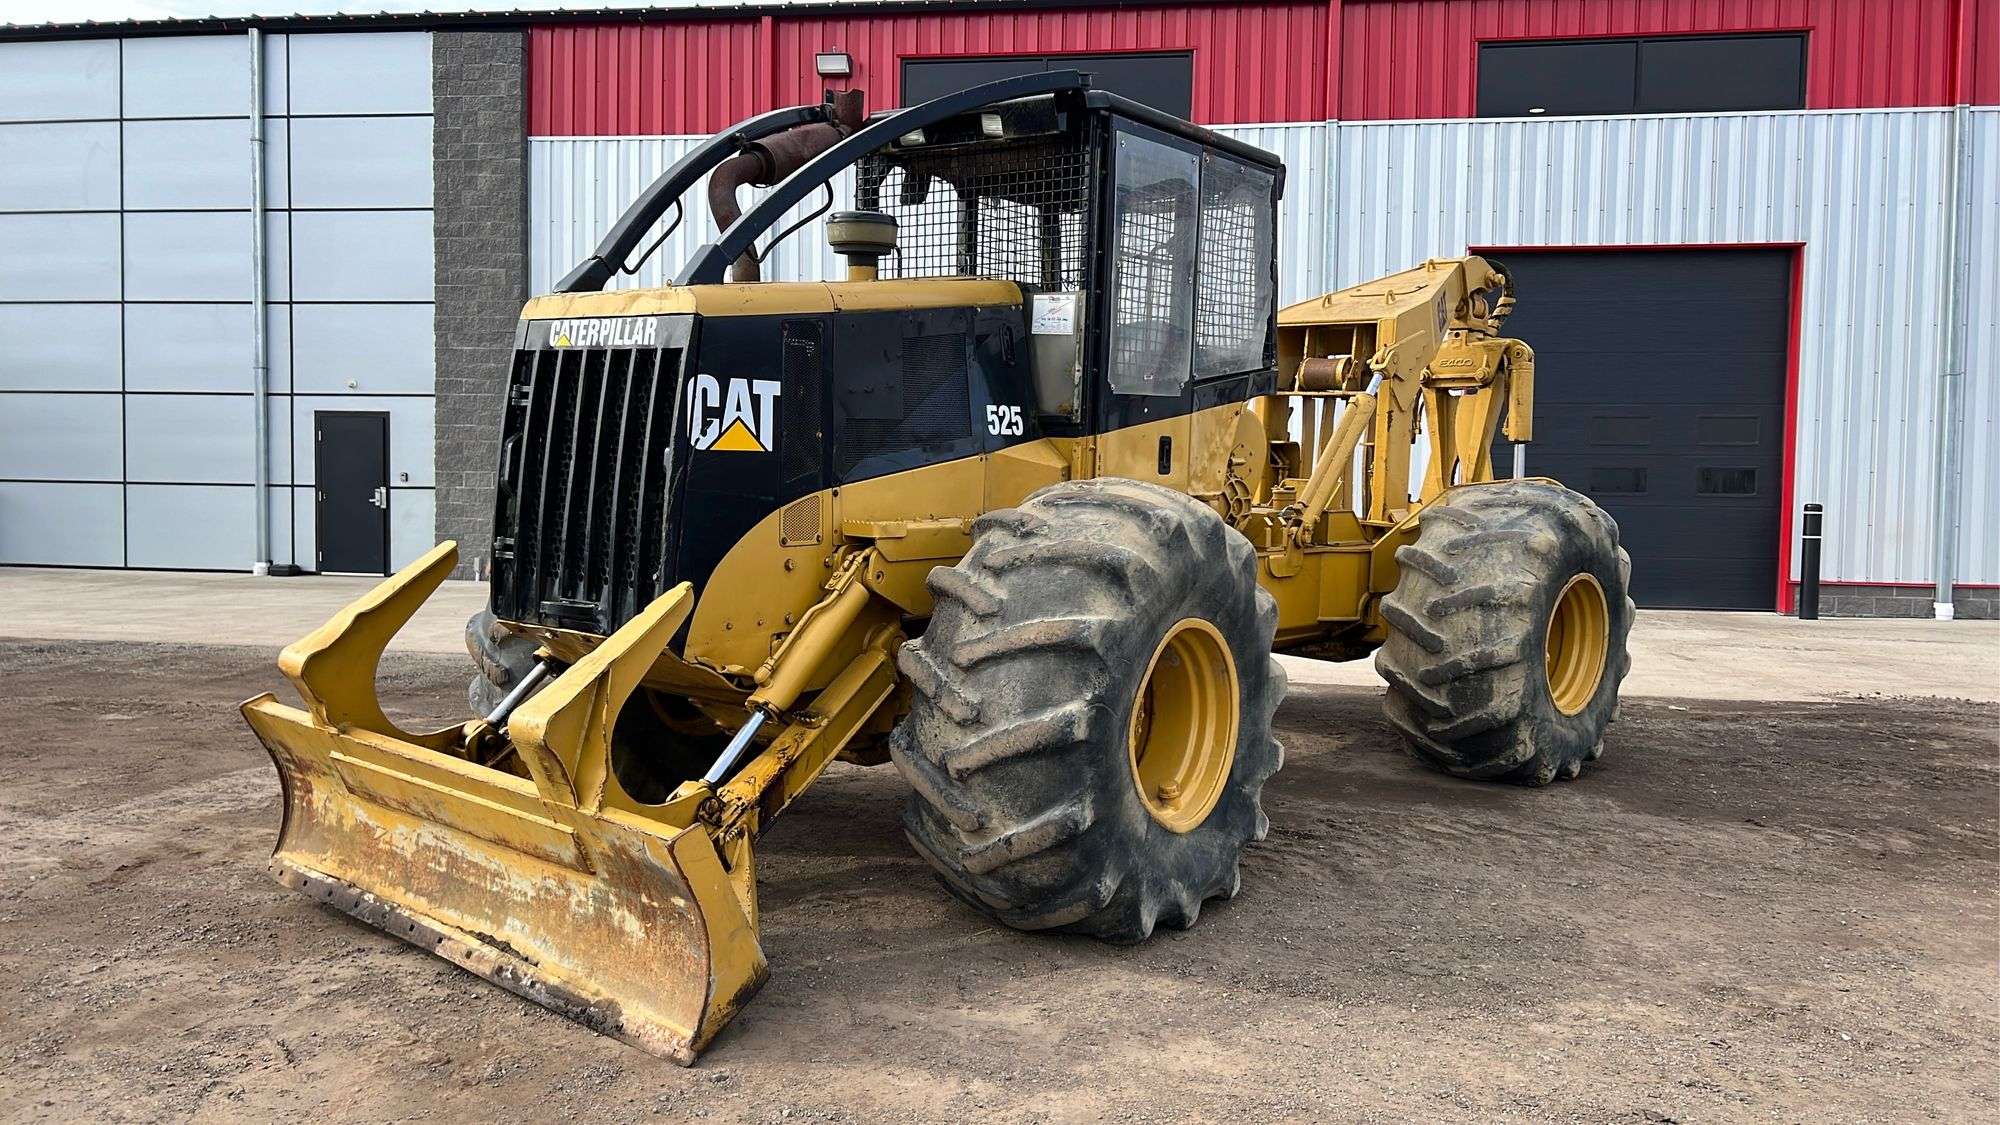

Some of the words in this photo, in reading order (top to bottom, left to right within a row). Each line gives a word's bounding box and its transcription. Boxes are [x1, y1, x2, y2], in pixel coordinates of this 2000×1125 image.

[549, 317, 657, 347] CATERPILLAR
[686, 374, 781, 452] CAT
[986, 404, 1024, 436] 525
